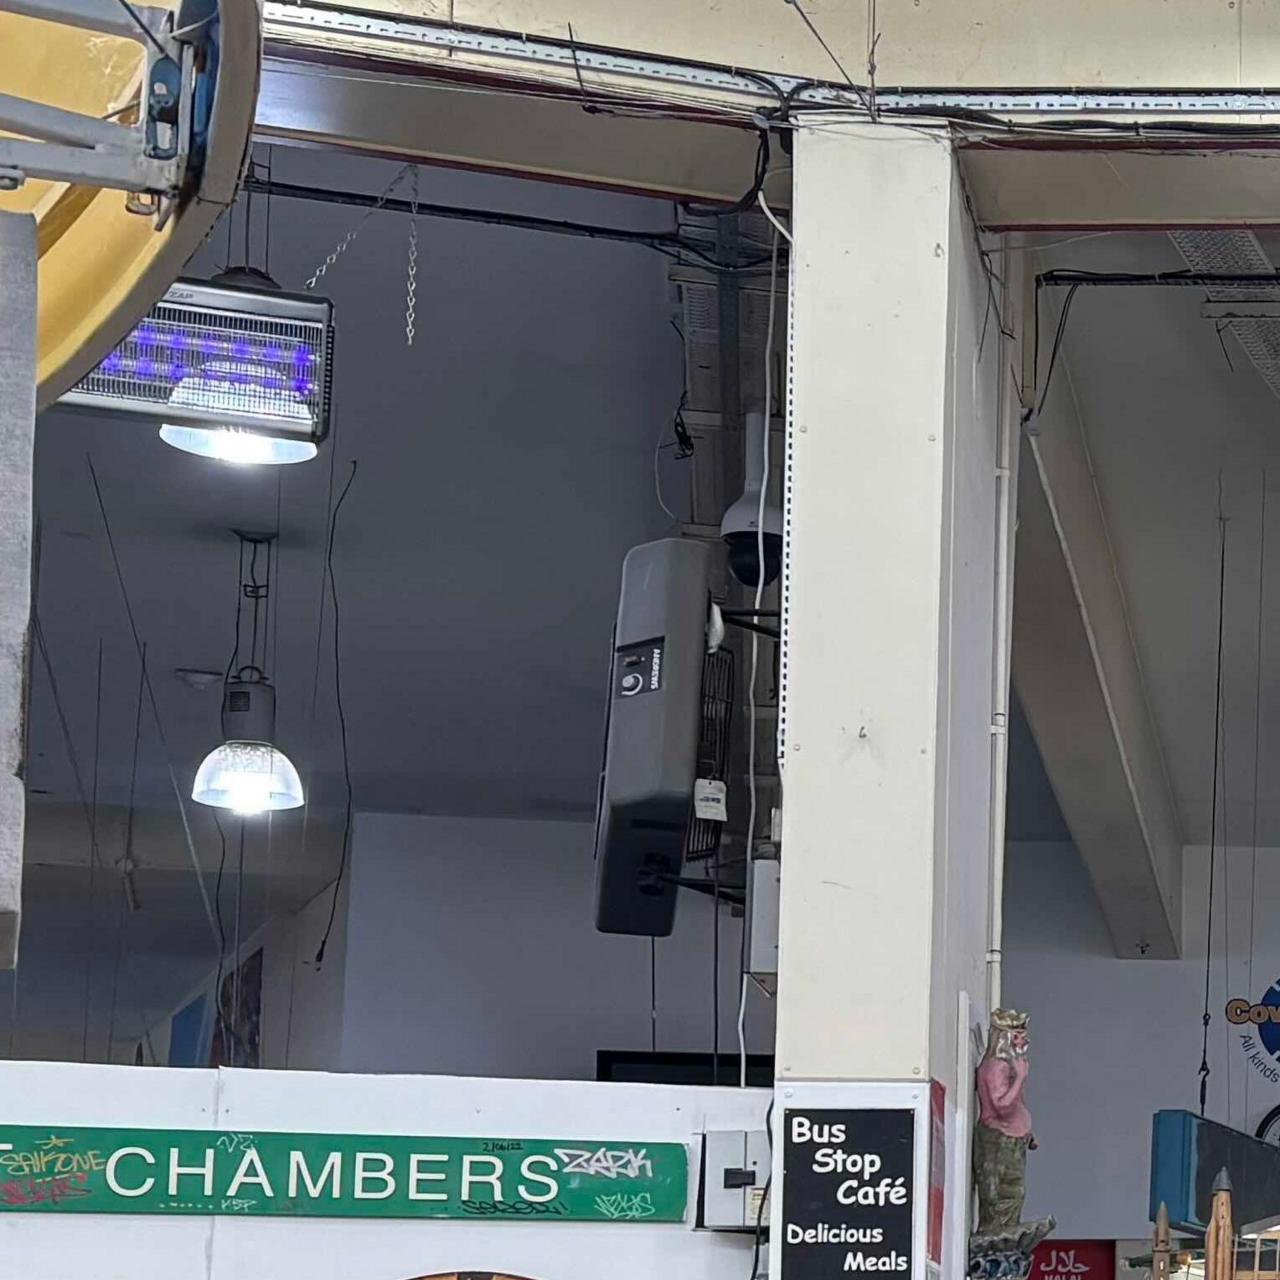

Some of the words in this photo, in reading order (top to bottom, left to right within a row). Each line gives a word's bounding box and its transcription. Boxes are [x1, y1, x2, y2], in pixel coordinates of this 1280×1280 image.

[1240, 1034, 1256, 1053] All
[1249, 1051, 1280, 1083] kinds
[791, 1116, 847, 1144] Bus
[104, 1146, 560, 1204] CHAMBERS
[812, 1148, 882, 1181] Stop
[836, 1177, 908, 1207] Café
[786, 1223, 884, 1244] Delicious
[843, 1250, 909, 1272] Meals
[1039, 1249, 1091, 1274] حلال
